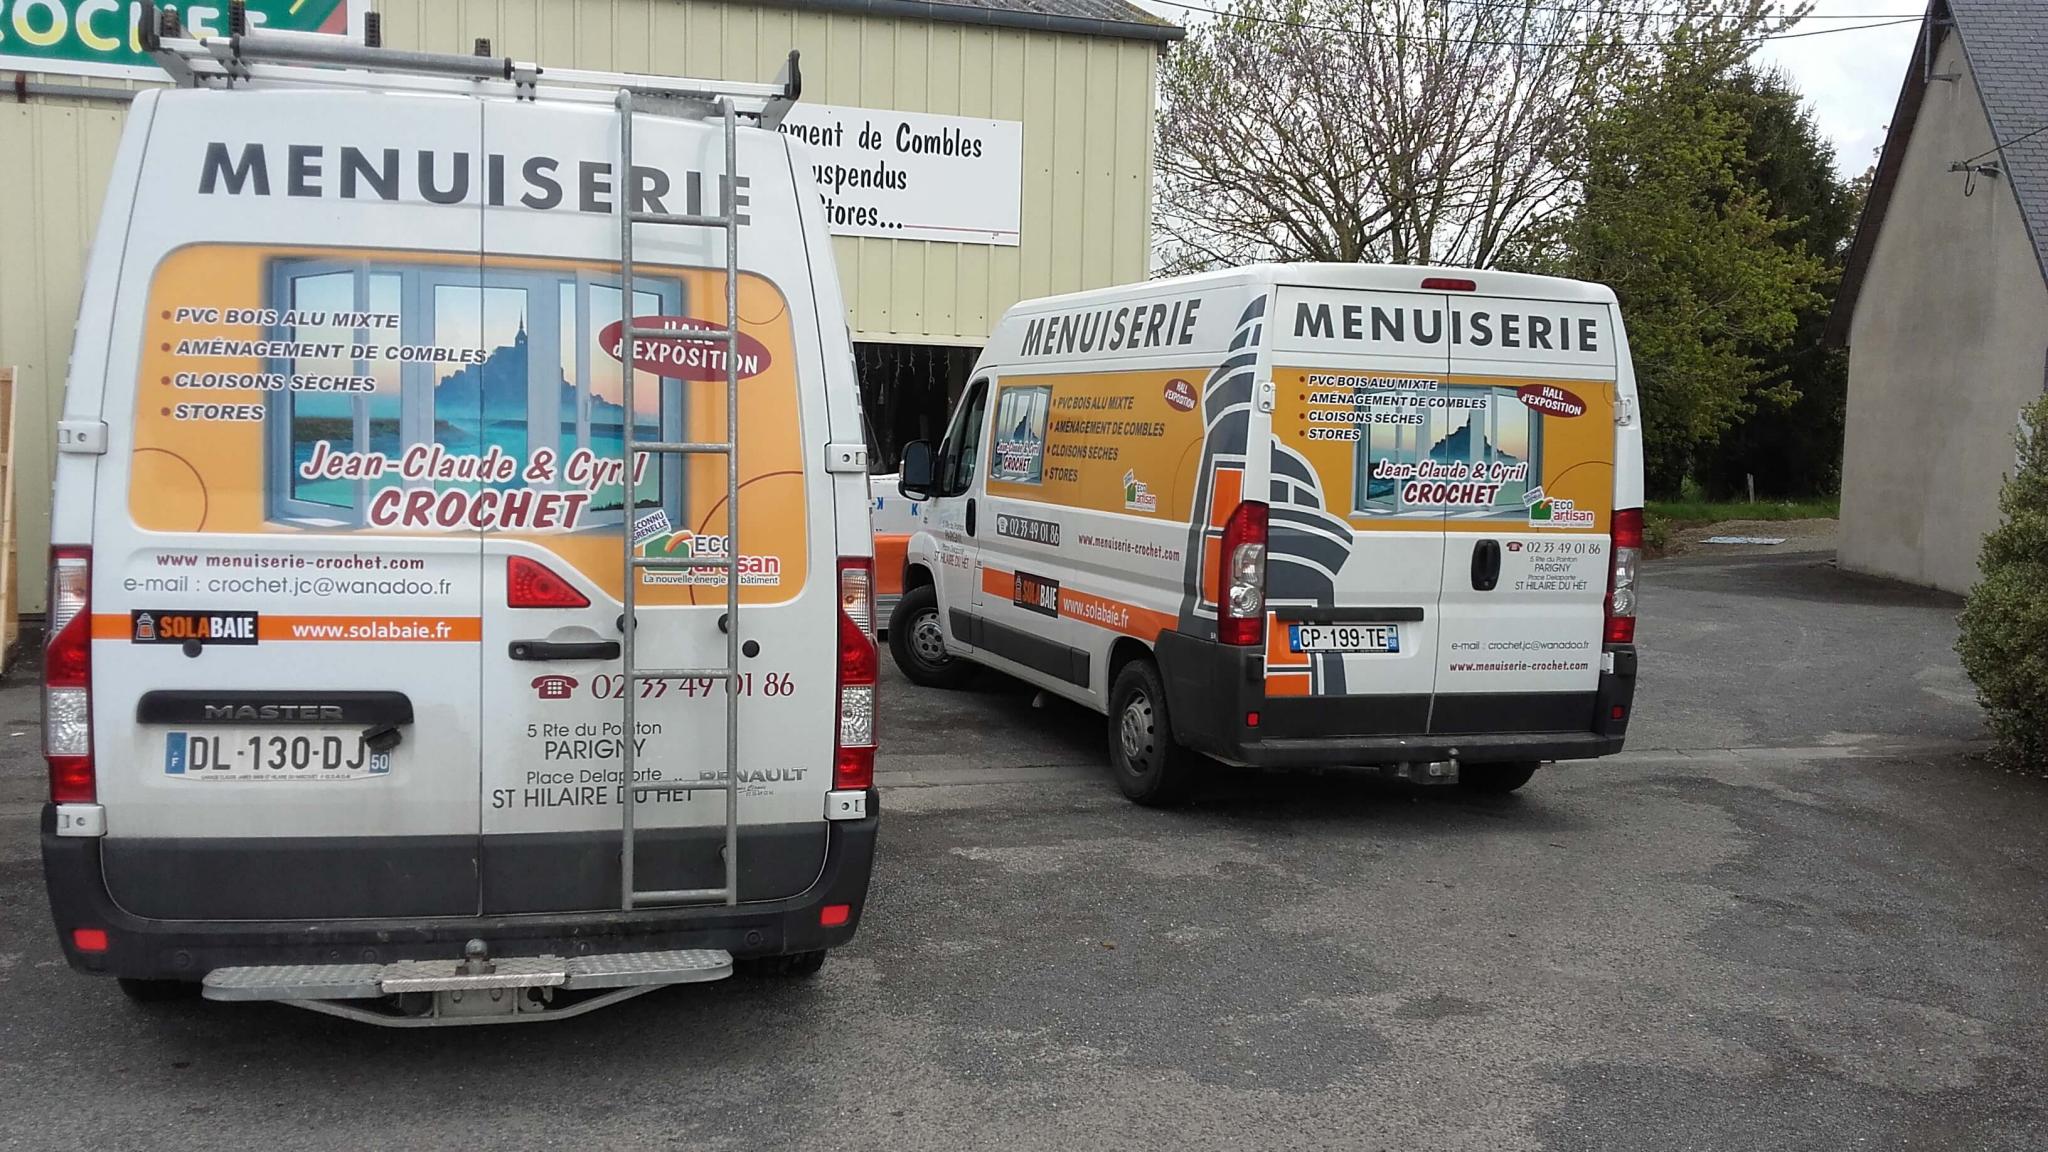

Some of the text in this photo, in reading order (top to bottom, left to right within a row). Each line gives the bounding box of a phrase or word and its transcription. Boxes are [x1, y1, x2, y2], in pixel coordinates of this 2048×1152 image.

[858, 121, 882, 150] de
[896, 122, 982, 157] Combles
[198, 142, 751, 226] MENUISERIE
[812, 160, 907, 195] uspendus
[175, 309, 399, 328] PVC BOIS ALU MIXTE
[1020, 299, 1201, 356] MENUISERIE
[1294, 303, 1597, 352] MENUISERIE
[176, 338, 487, 363] AMÉNAGEMENT DE COMBLES
[175, 373, 375, 391] CLOISONS SÈCHES
[1309, 376, 1437, 389] PVC BOIS ALU MIXTE
[1309, 392, 1487, 409] AMÉNAGEMENT DE COMBLES
[1542, 387, 1564, 400] HALL
[1072, 397, 1092, 409] BOIS
[1091, 397, 1108, 409] ALU
[1108, 396, 1134, 409] MIXTE
[1521, 394, 1582, 415] d'EXPOSITION
[175, 405, 264, 419] STORES
[1309, 411, 1372, 423] CLOISONS
[1112, 422, 1122, 434] DE
[1124, 422, 1165, 436] COMBLES
[1309, 429, 1360, 440] STORES
[1051, 444, 1087, 457] CLOISONS
[303, 444, 646, 490] Jean-Claude & Cyrl
[1049, 467, 1078, 481] STORES
[1375, 460, 1528, 483] Jean-Claude & Cyril
[1404, 484, 1499, 503] CROCHET
[371, 489, 588, 529] CROCHET
[1554, 501, 1573, 510] ECO
[1554, 510, 1593, 520] artisan
[1010, 518, 1019, 535] 02
[1029, 522, 1038, 539] 49
[1041, 524, 1048, 542] 01
[1050, 526, 1059, 544] 86
[1078, 534, 1179, 561] www.menuiserie-crochet.com
[1527, 542, 1601, 554] 02 33 49 01 86
[156, 554, 424, 570] www menuiserie-crochet.com
[1535, 563, 1571, 572] PARIGNY
[124, 576, 188, 593] e-mail
[208, 577, 452, 596] crochet.jc@wanadoo.fr
[644, 575, 654, 583] La
[656, 574, 692, 583] nouvelle
[694, 575, 726, 585] énergie
[1515, 582, 1524, 590] ST
[1526, 581, 1556, 590] HILAIRE
[1559, 582, 1570, 590] DU
[1063, 598, 1128, 628] www.solabaie.fr
[159, 616, 254, 639] SOLABAIE
[292, 622, 452, 639] www.solabaie.fr
[1451, 641, 1480, 650] e-mail
[1488, 641, 1589, 651] crochet.jc@wanadoo.fr
[1450, 660, 1588, 671] www.menuiserie-crochet.com
[591, 674, 624, 699] 02
[679, 678, 714, 697] 49
[764, 673, 795, 697] 86
[204, 705, 343, 720] MASTER
[527, 721, 662, 738] 5 Rte du Poton
[171, 757, 178, 767] F
[371, 754, 388, 770] 50
[527, 771, 574, 784] Place
[493, 789, 516, 808] ST
[524, 786, 607, 807] HILAIRE
